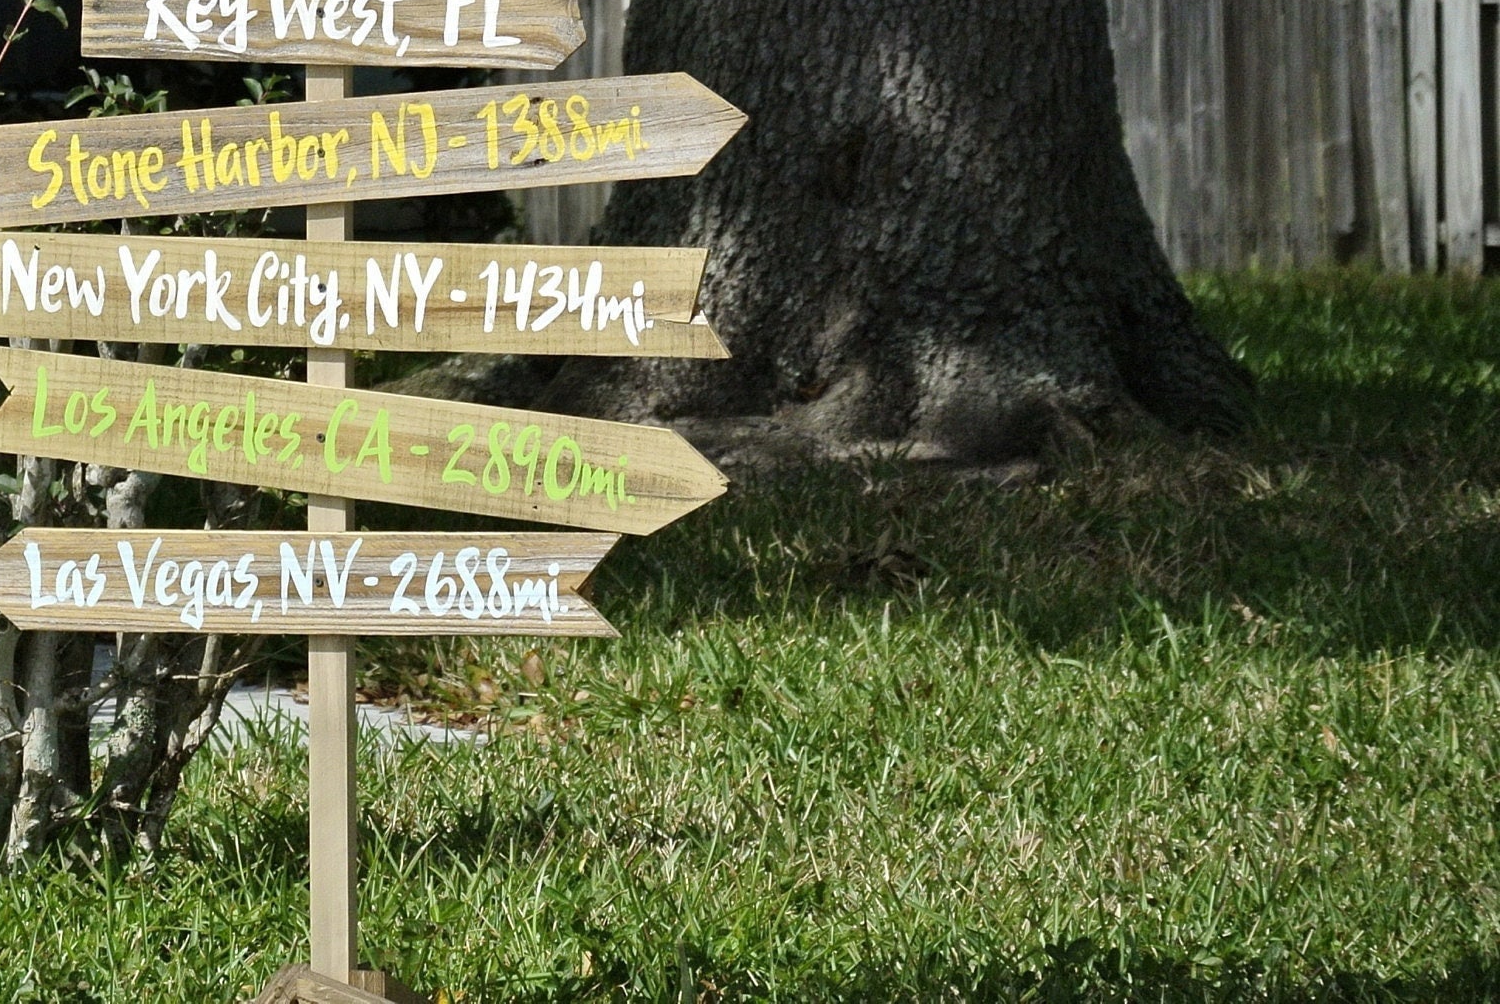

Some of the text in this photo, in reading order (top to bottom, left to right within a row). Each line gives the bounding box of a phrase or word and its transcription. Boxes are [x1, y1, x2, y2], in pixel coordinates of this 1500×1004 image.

[28, 128, 168, 210] Stone
[177, 110, 357, 193] Harbor,
[370, 103, 438, 180] NJ
[477, 93, 650, 170] 1388mi.
[1, 239, 105, 316] New
[118, 244, 242, 331] York
[248, 250, 351, 346] City,
[366, 252, 444, 335] NY
[479, 260, 654, 347] 1434mi.
[31, 366, 117, 439] Los
[124, 378, 305, 474] Angeles,
[324, 398, 393, 483] CA
[442, 421, 637, 511] 2890mi.
[23, 541, 106, 610] Las
[116, 537, 263, 630] Vegas,
[280, 538, 362, 615] NV
[389, 547, 569, 624] 2688mi.
